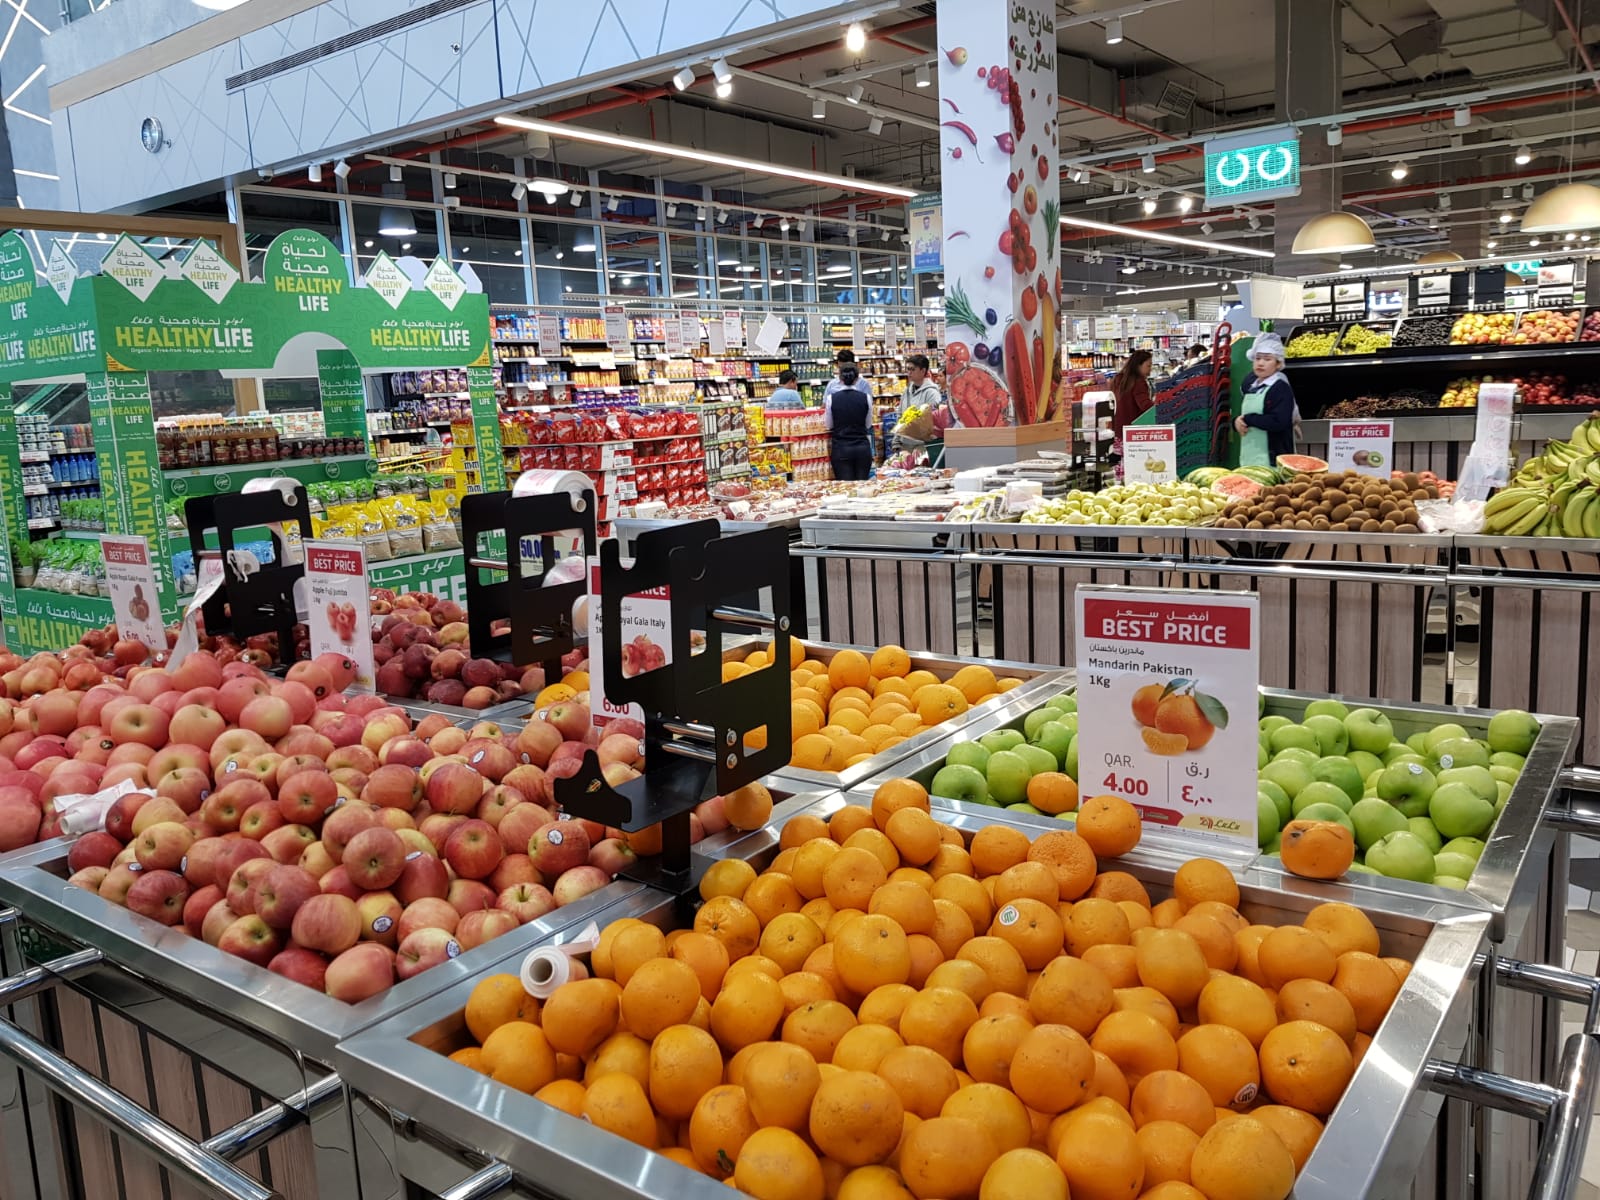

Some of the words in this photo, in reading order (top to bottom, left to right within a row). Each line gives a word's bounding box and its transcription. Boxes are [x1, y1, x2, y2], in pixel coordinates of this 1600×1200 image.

[1011, 3, 1026, 24] من
[1028, 12, 1054, 38] طازج
[282, 242, 326, 260] لحياة
[112, 268, 152, 278] HEALTHY
[282, 258, 329, 276] صحية
[126, 278, 144, 286] LIFE
[190, 272, 228, 280] HEALTHY
[202, 282, 219, 290] LIFE
[274, 276, 342, 294] HEALTHY
[440, 292, 452, 300] LIFE
[299, 295, 329, 312] LIFE
[10, 302, 28, 320] LIFE
[131, 316, 153, 324] LuLu
[480, 398, 490, 406] LIFE
[112, 406, 151, 416] HEALTHY
[125, 416, 144, 424] LIFE
[109, 550, 122, 560] BEST
[124, 552, 141, 562] PRICE
[314, 558, 332, 570] BEST
[334, 560, 356, 572] PRICE
[1116, 609, 1158, 618] سعر
[1166, 611, 1209, 622] أفضل
[634, 616, 648, 626] Gala
[650, 618, 666, 630] Italy
[1102, 618, 1154, 638] BEST
[1164, 623, 1226, 644] PRICE
[1088, 658, 1140, 672] Mandarin
[1144, 662, 1192, 676] Pakistan
[1090, 675, 1110, 688] 1Kg
[1104, 752, 1134, 768] QAR.
[1186, 762, 1210, 778] ر.ق
[1103, 772, 1148, 796] 4.00
[1214, 819, 1240, 830] LuLu
